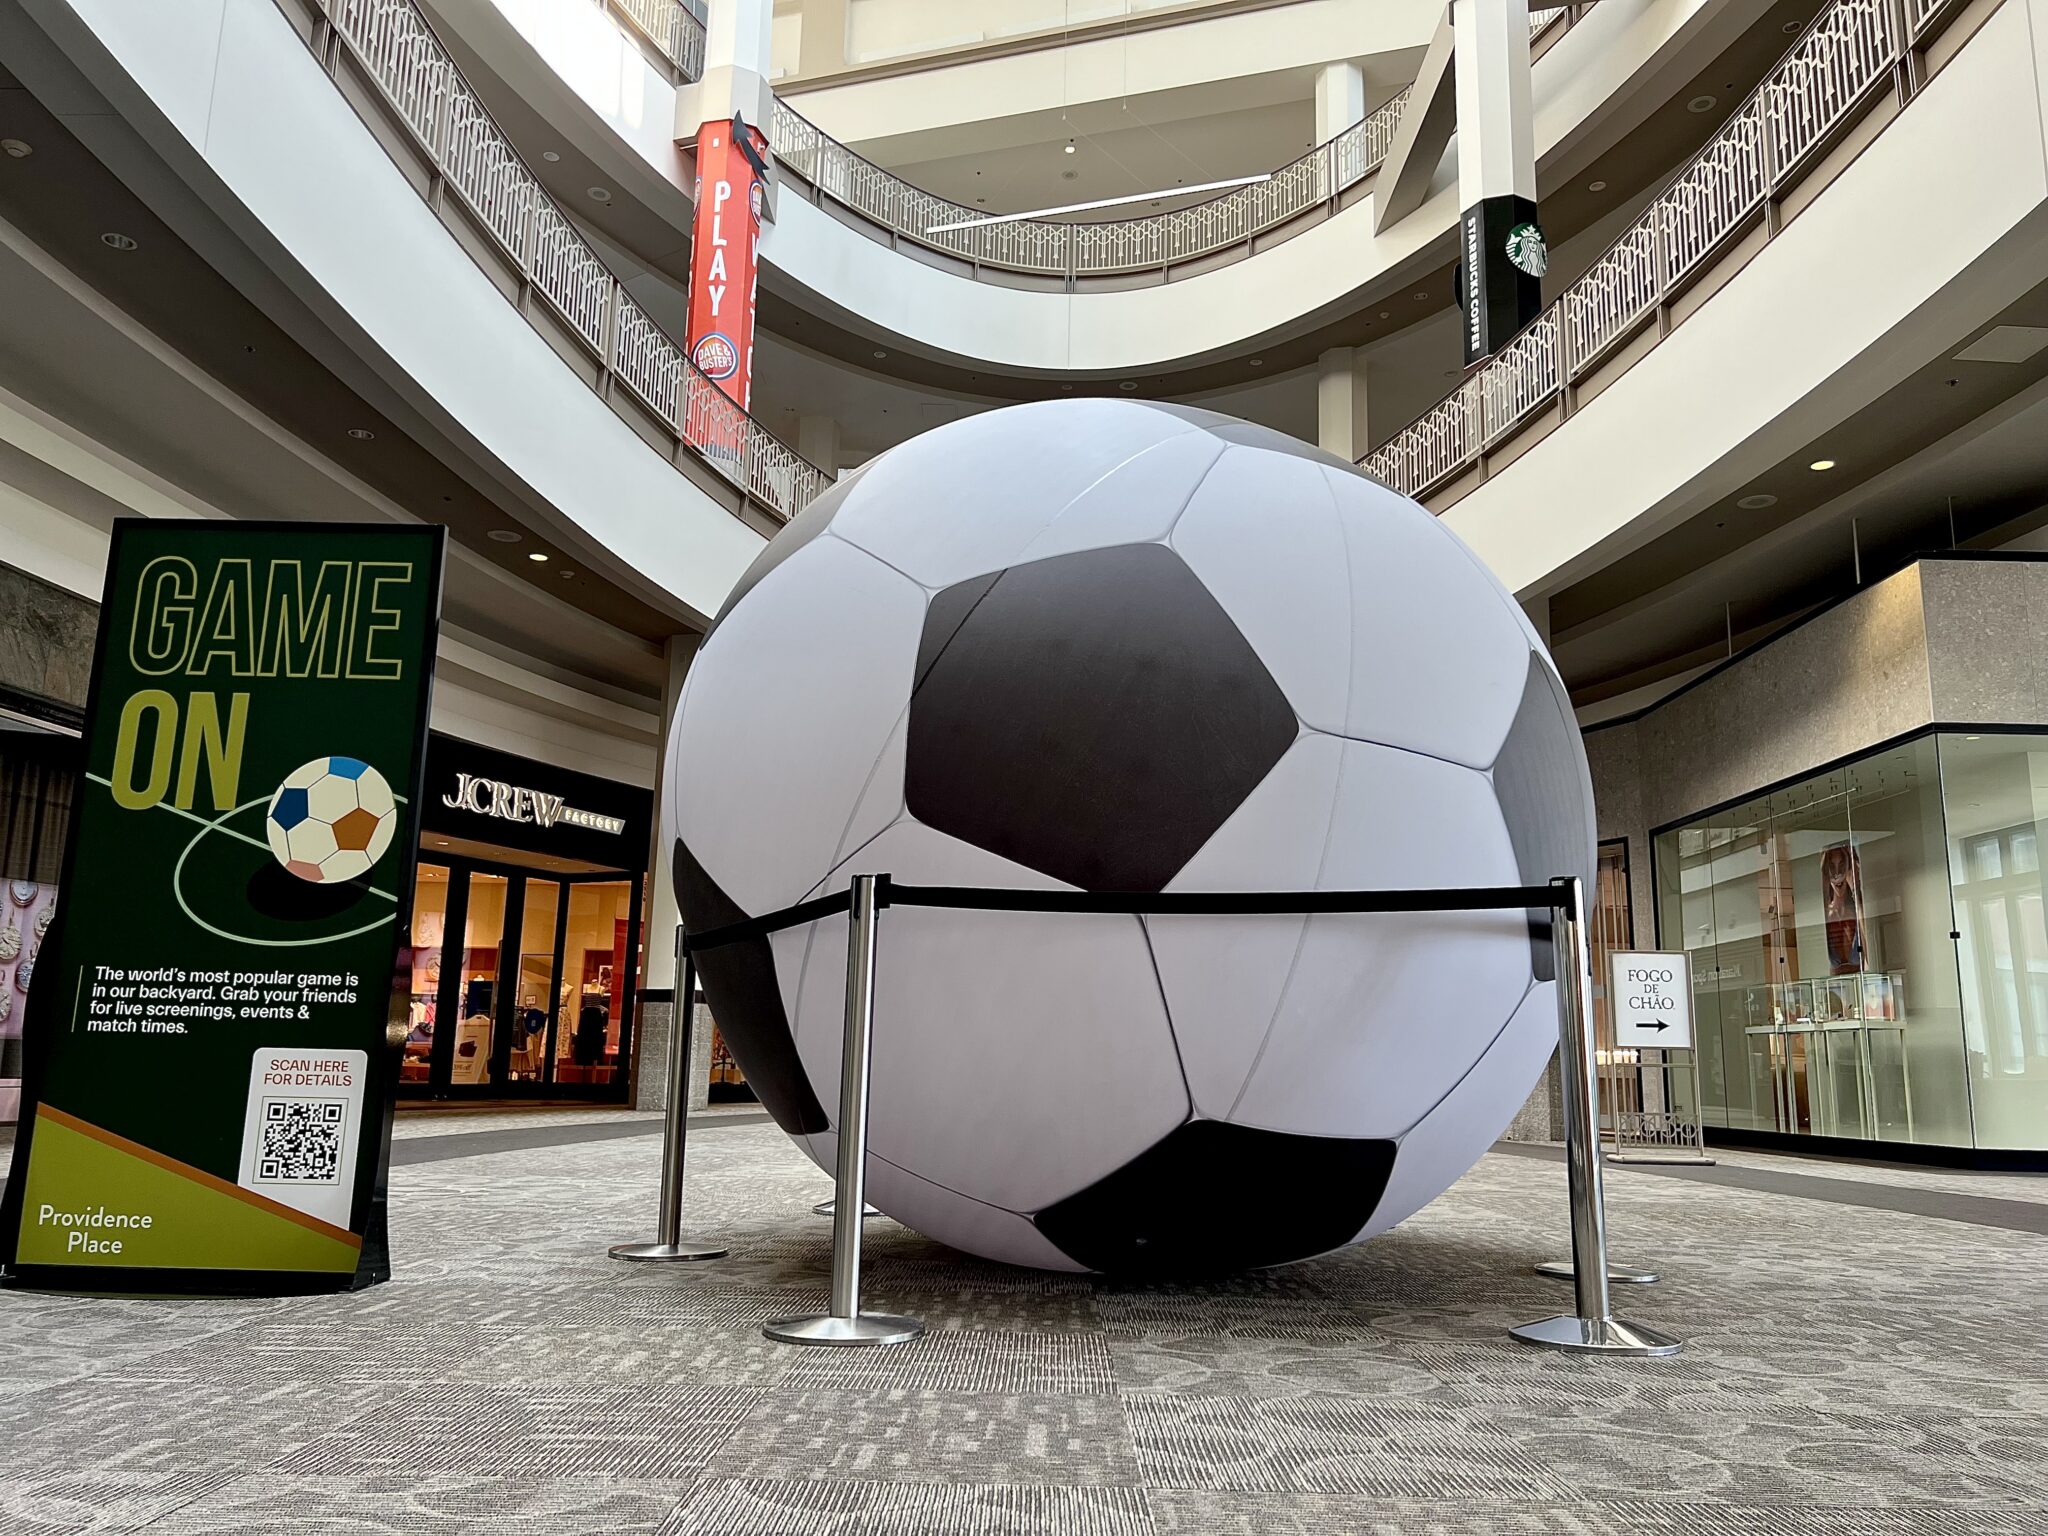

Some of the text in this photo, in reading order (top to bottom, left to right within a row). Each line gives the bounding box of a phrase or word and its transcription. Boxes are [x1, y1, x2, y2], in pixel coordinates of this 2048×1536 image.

[708, 180, 731, 316] PLAY
[1466, 217, 1481, 351] STARBUCKS COFFEE
[698, 343, 731, 359] DAVE &
[698, 356, 732, 371] BUSTER'S
[129, 555, 414, 681] GAME
[111, 689, 250, 811] ON
[564, 809, 619, 832] FACTORY
[95, 966, 359, 988] The world's most popular game is
[1627, 969, 1673, 983] FOGO
[92, 983, 357, 1004] in our backyard. Grab your friends
[1643, 984, 1659, 994] DE
[90, 1000, 310, 1021] for live screenings, events &
[1628, 994, 1675, 1010] CHÃO
[87, 1018, 189, 1034] match times.
[270, 1059, 349, 1072] SCAN HERE
[264, 1073, 352, 1087] FOR DETAILS
[38, 1204, 153, 1229] Providence
[67, 1231, 123, 1254] Place
